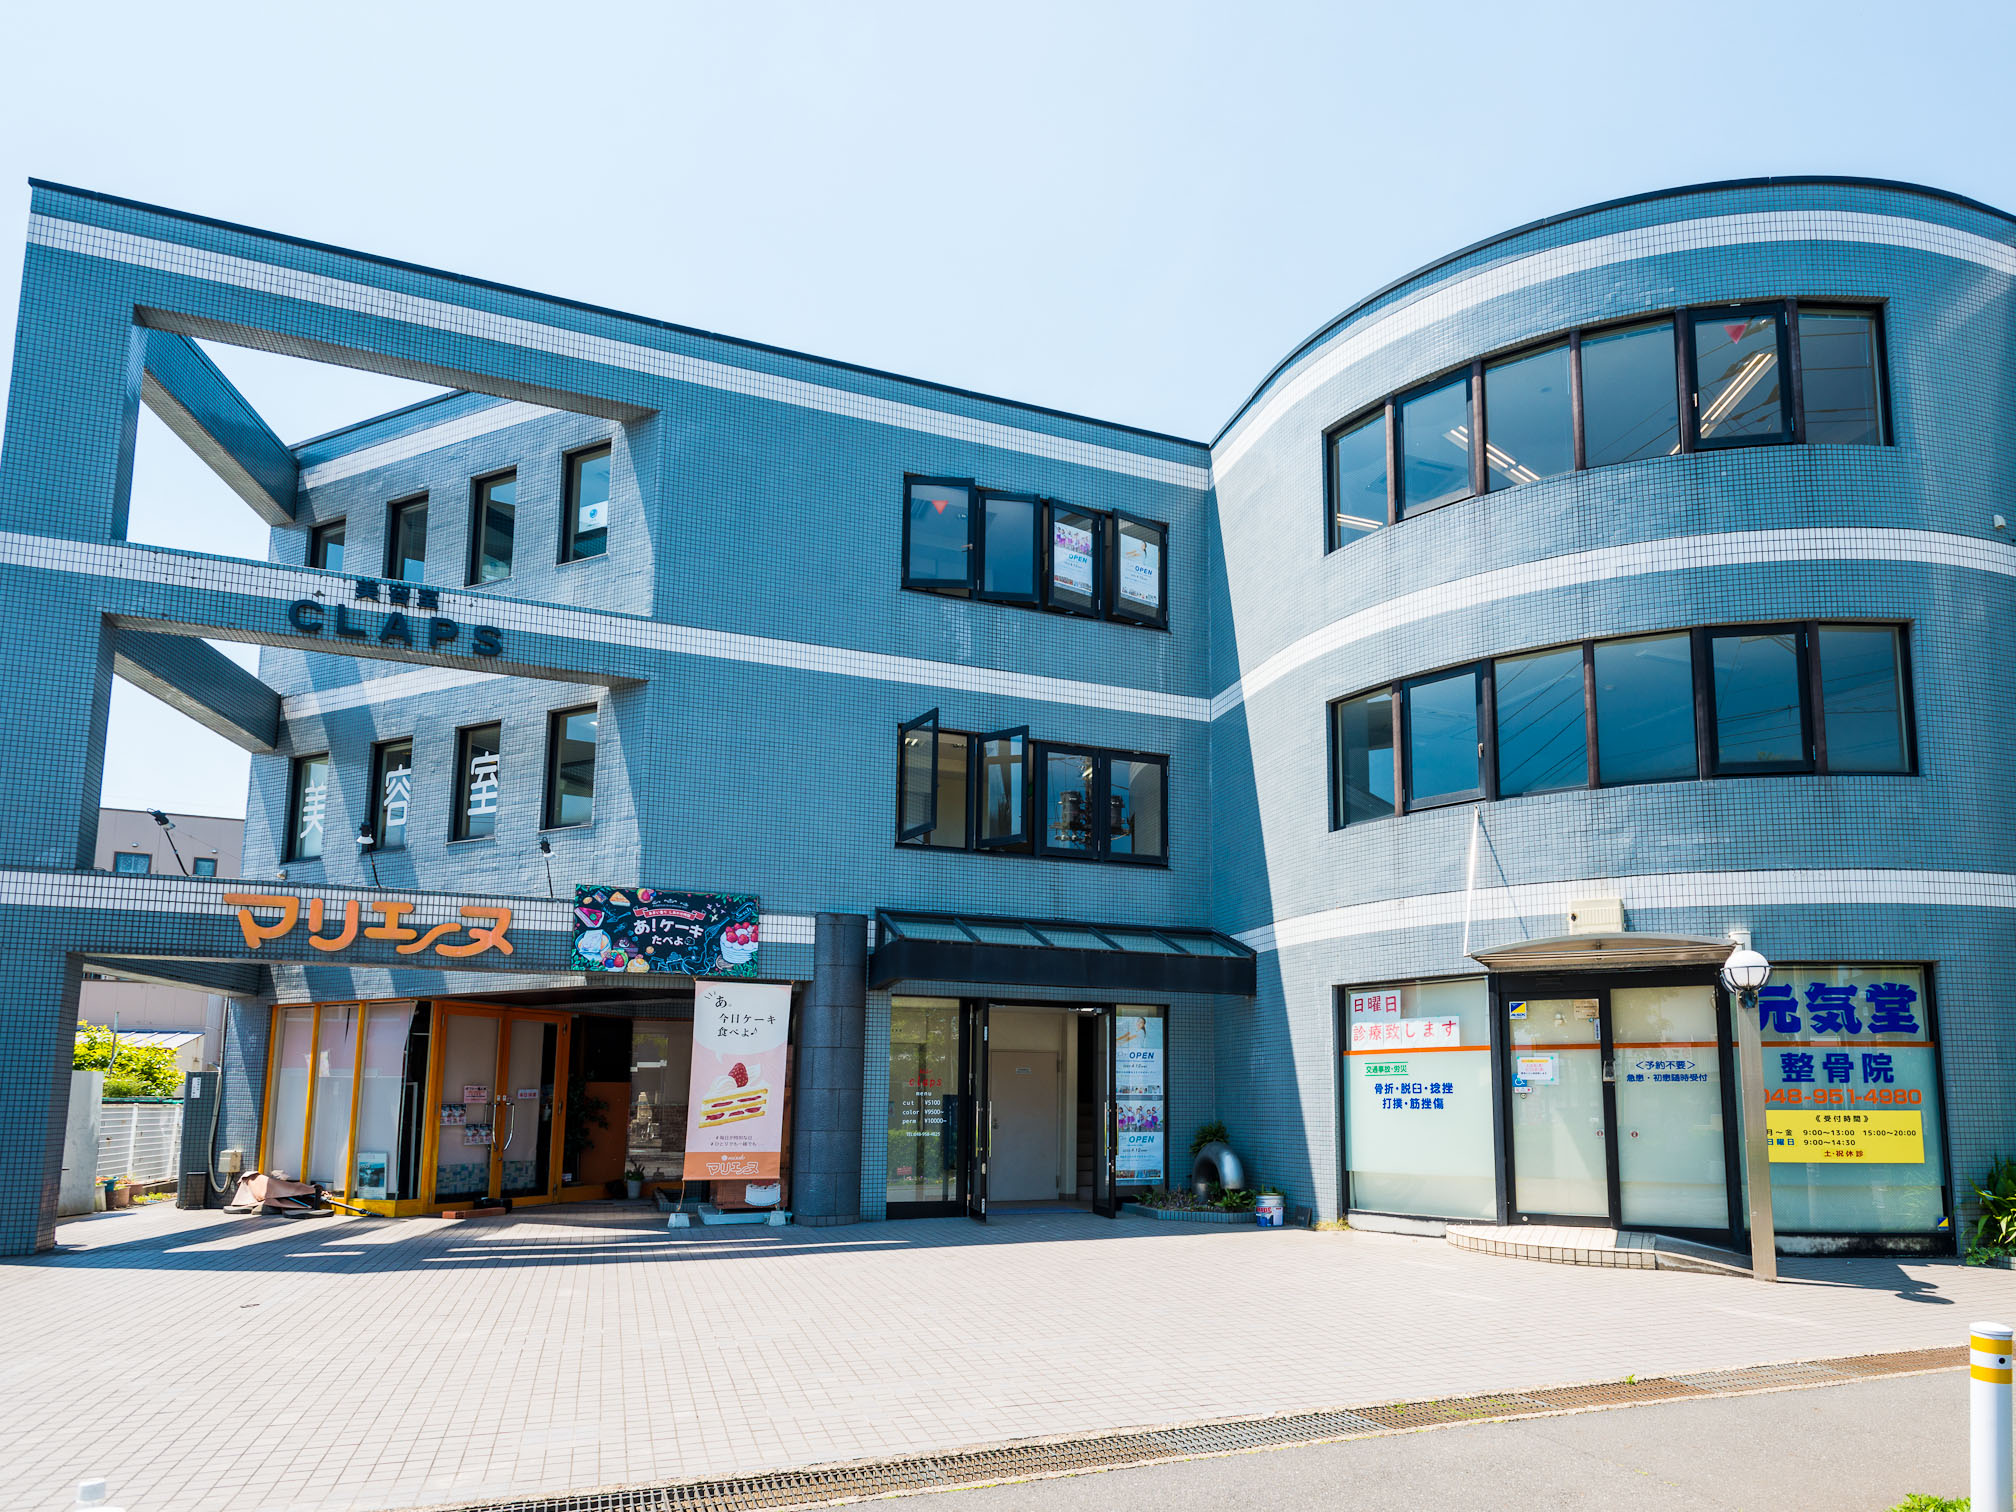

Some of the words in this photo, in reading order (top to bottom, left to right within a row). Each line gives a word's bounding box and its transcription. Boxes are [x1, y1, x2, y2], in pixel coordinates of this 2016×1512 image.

[1069, 553, 1088, 564] OPEN
[1135, 565, 1153, 576] OPEN
[288, 599, 503, 656] CLAPS
[652, 935, 683, 946] たべよ
[1354, 995, 1397, 1013] 日曜日
[1758, 982, 1920, 1034] 元気堂
[719, 1013, 776, 1024] 今日ケーキ
[1353, 1020, 1457, 1041] 診療致します
[1129, 1051, 1154, 1059] OPEN
[1780, 1053, 1894, 1083] 整骨院
[909, 1076, 943, 1088] claps
[1374, 1082, 1454, 1095] 骨折・脱臼・捻挫
[1382, 1097, 1444, 1109] 打撲・筋挫傷
